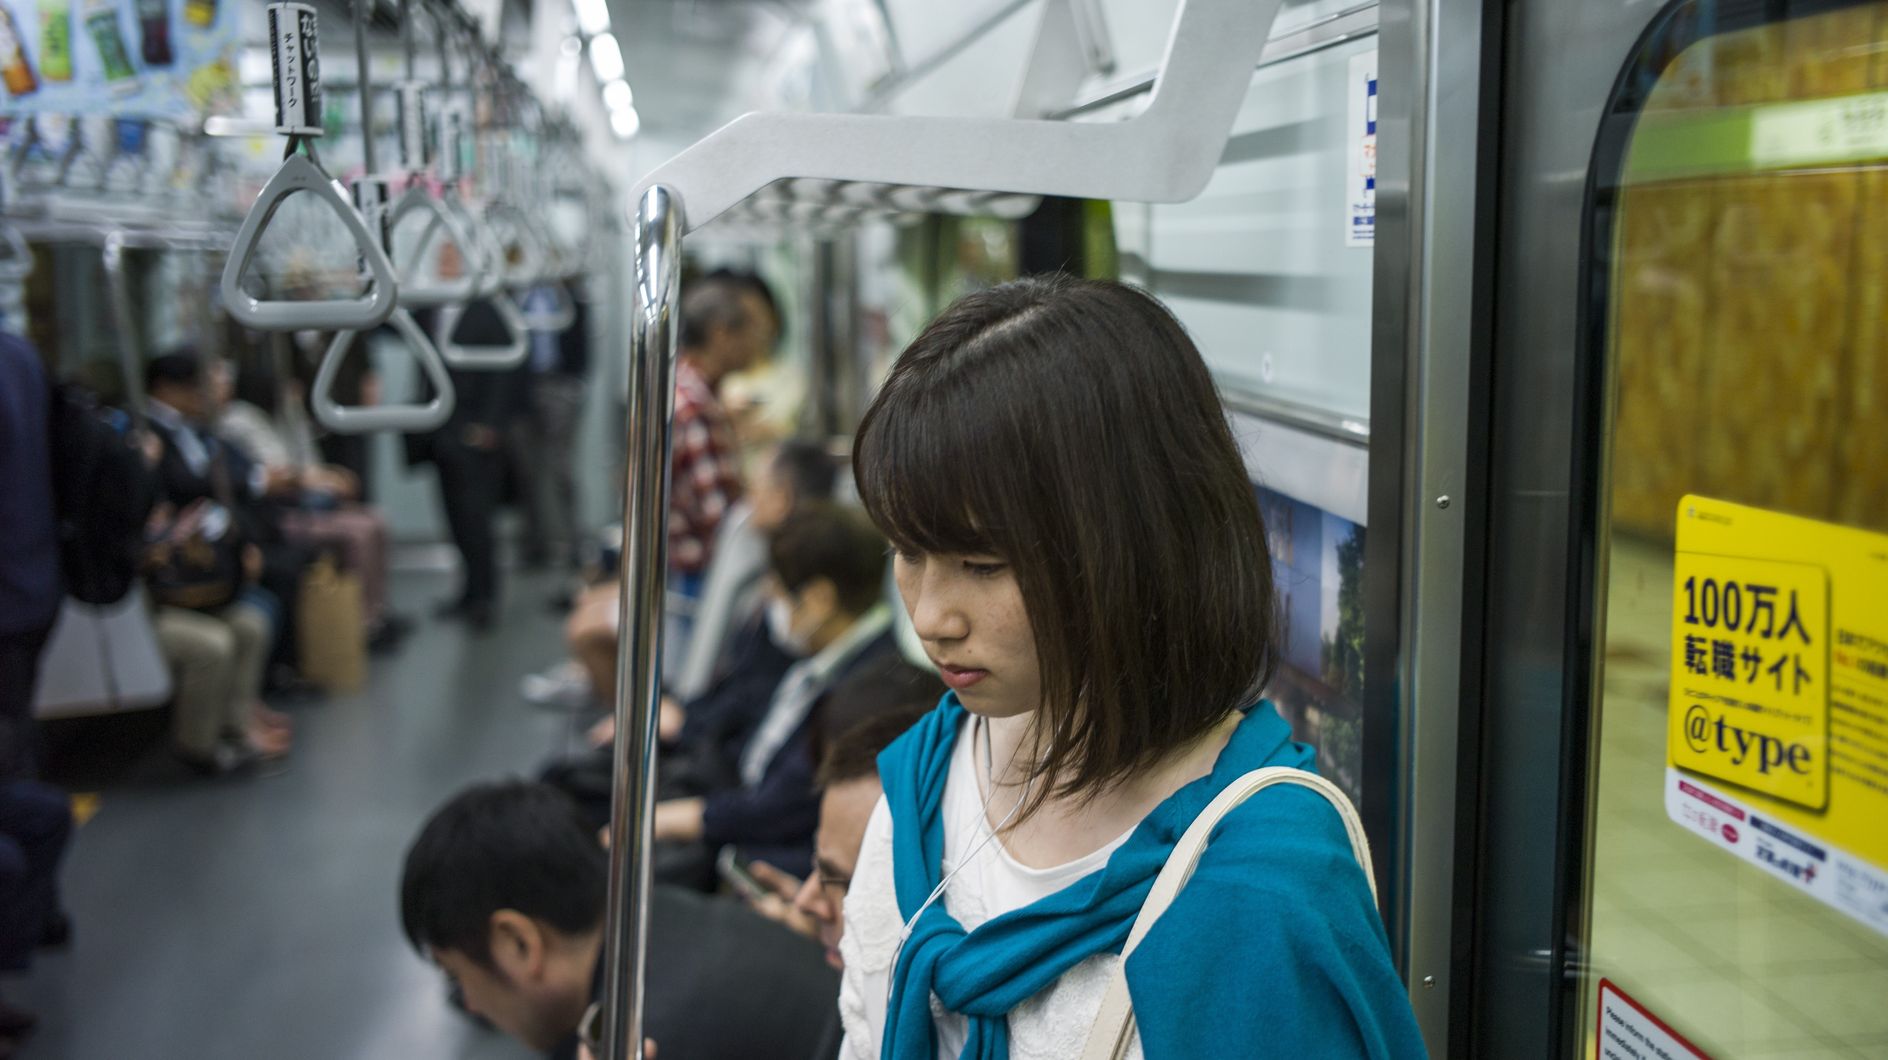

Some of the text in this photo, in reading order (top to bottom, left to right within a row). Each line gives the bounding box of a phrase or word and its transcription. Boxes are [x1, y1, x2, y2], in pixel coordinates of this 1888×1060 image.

[284, 32, 298, 108] チャットワーク
[1684, 576, 1811, 645] 100万人
[1684, 633, 1812, 696] 転職サイト
[1684, 704, 1811, 775] @type
